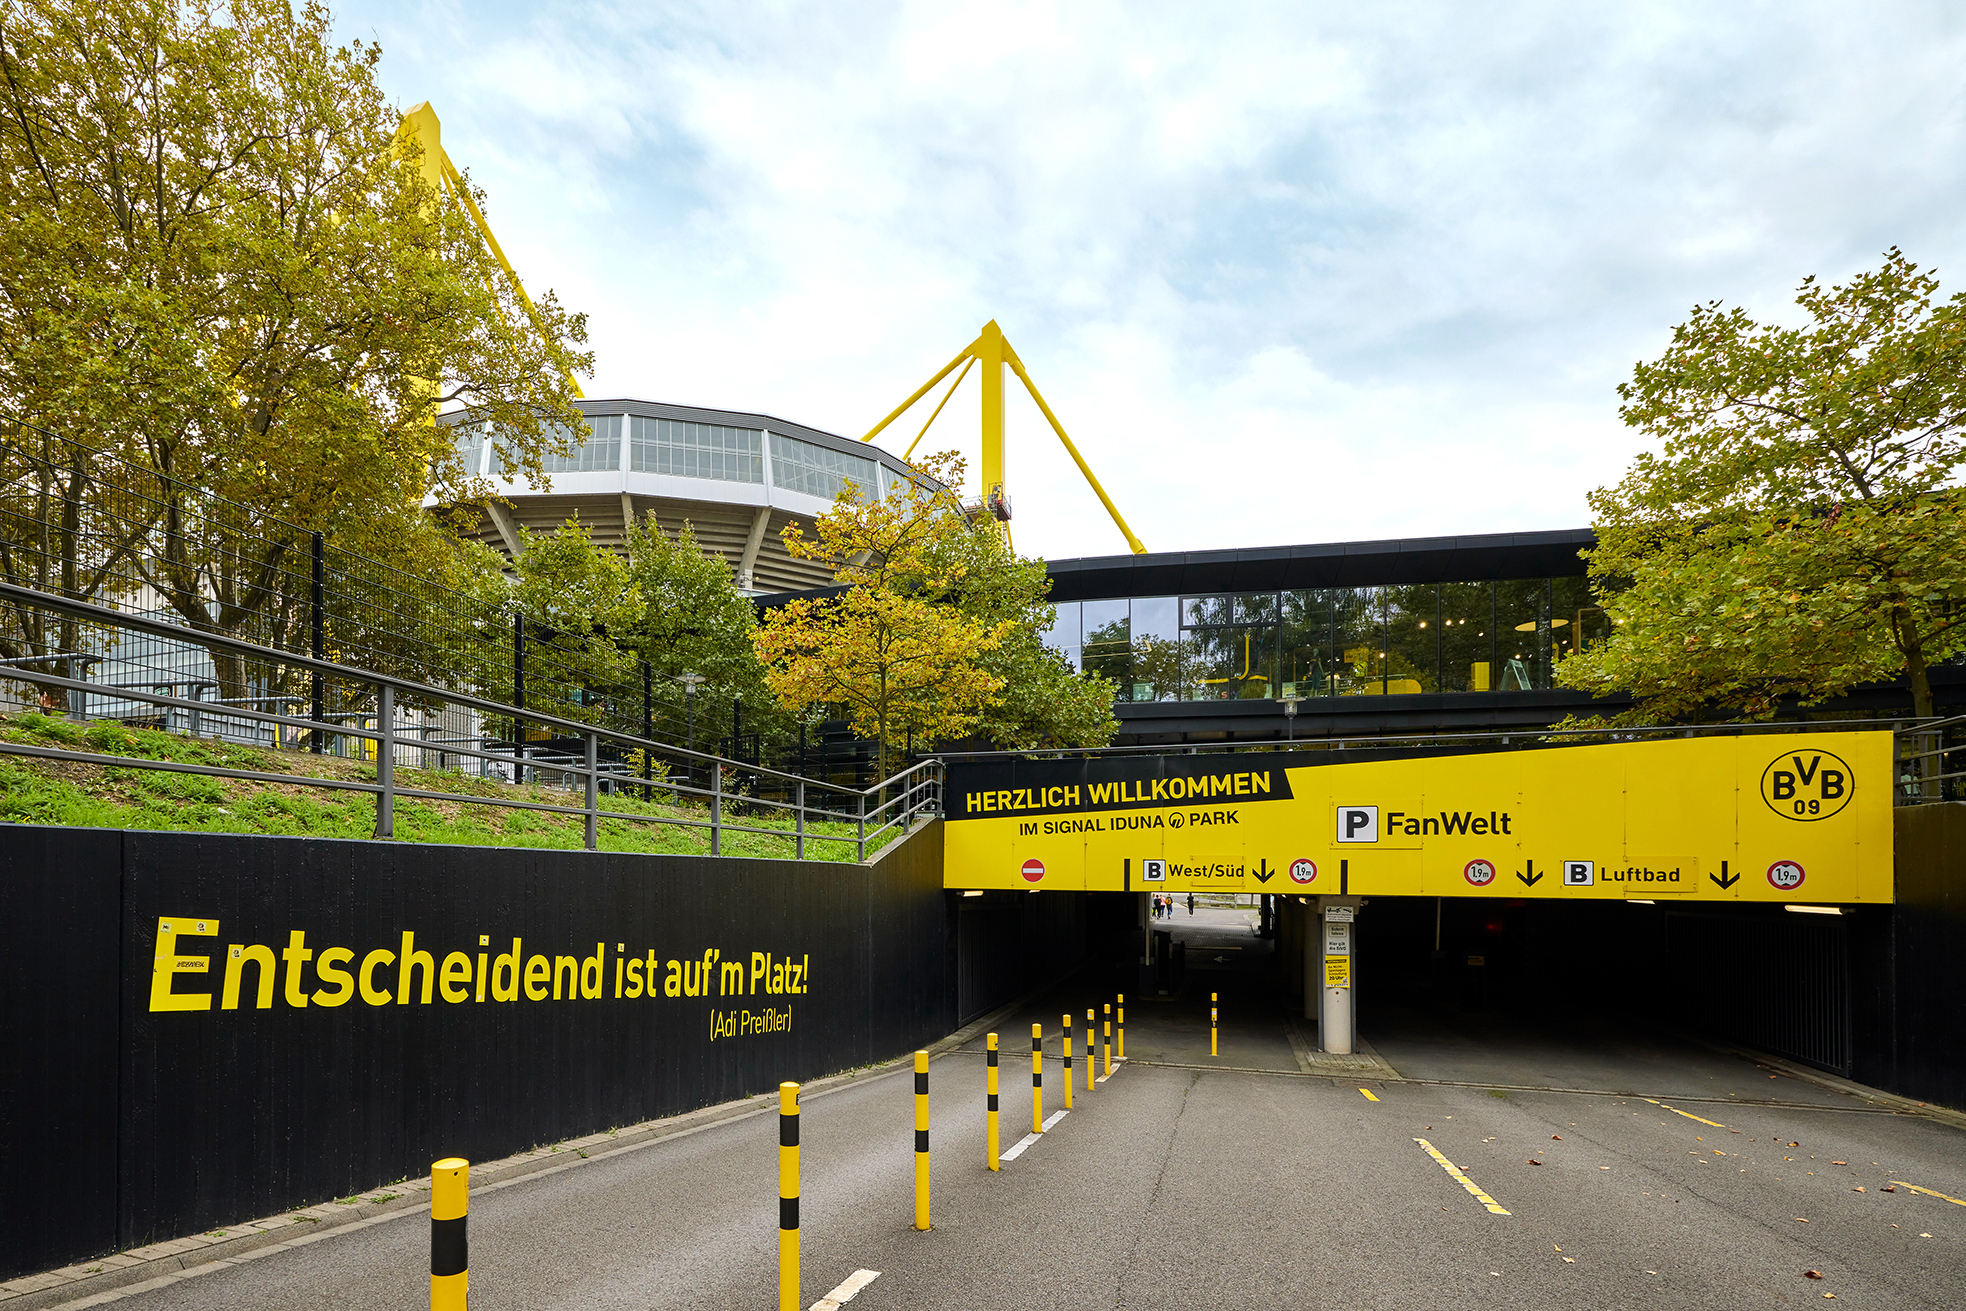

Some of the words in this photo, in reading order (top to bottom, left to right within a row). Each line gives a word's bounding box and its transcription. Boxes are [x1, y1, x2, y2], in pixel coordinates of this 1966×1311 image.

[1773, 756, 1844, 800] BVB
[966, 785, 1080, 813] HERZLICH
[1088, 771, 1271, 805] WILLKOMMEN
[1794, 800, 1819, 815] 09
[1020, 823, 1037, 836] IM
[1043, 819, 1106, 835] SIGNAL
[1111, 815, 1164, 832] IDUNA
[1190, 811, 1240, 827] PARK
[1347, 811, 1370, 839] P
[1388, 812, 1512, 836] FanWelt
[1149, 863, 1161, 879] B
[1169, 863, 1245, 879] West/Süd
[1571, 864, 1588, 883] B
[1601, 867, 1680, 882] Luftbad
[149, 917, 604, 1012] Entscheidend
[615, 943, 657, 999] ist
[665, 949, 743, 998] auf'm
[750, 952, 809, 995] Platz!
[710, 1009, 737, 1042] (Adi
[741, 1005, 792, 1036] Preißler)
